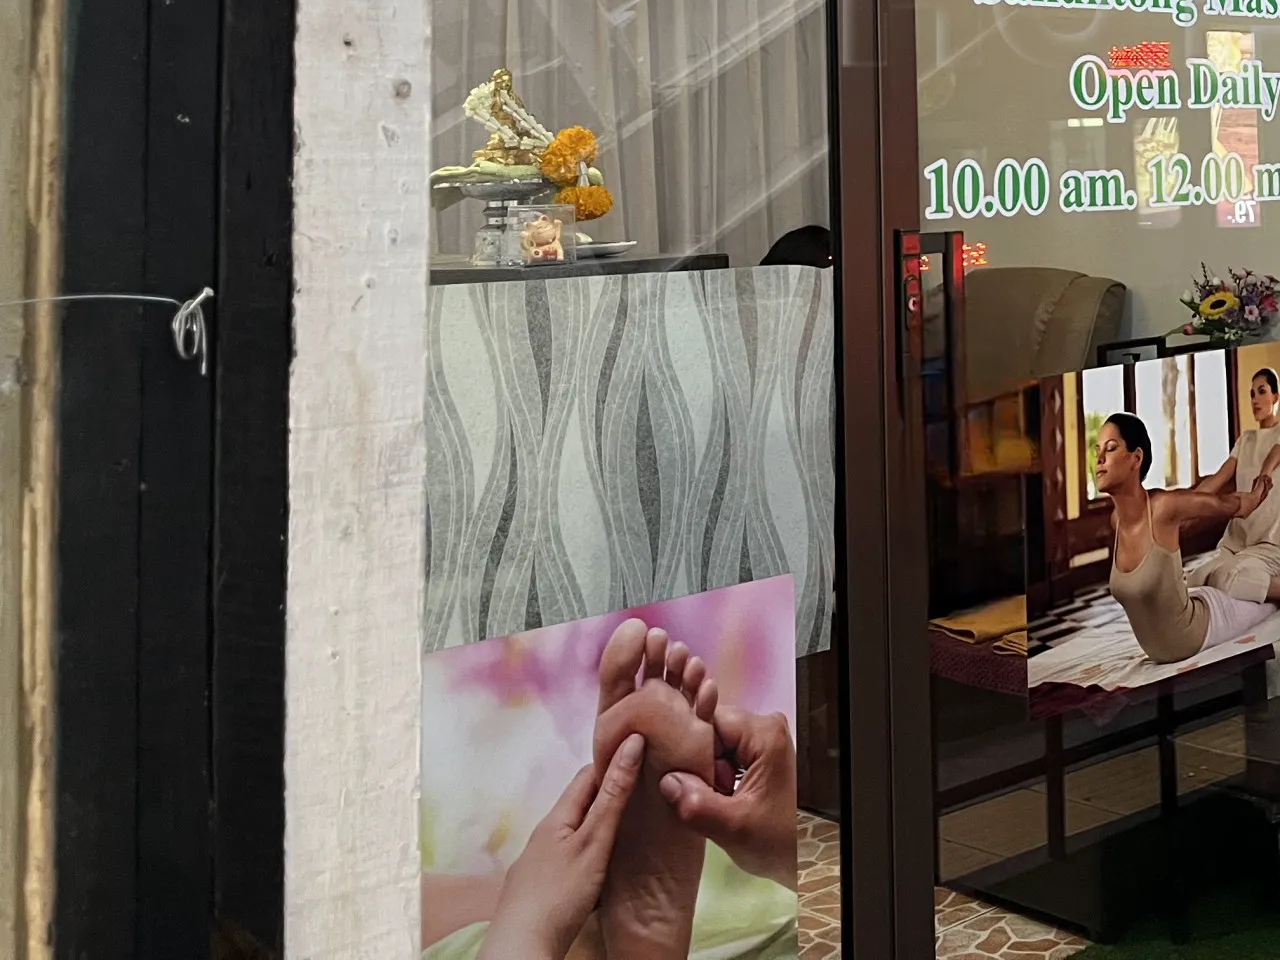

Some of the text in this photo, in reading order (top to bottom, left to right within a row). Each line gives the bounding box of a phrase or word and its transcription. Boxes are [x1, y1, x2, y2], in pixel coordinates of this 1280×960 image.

[1072, 56, 1179, 120] Open
[925, 159, 1048, 218] 10.00
[1060, 170, 1136, 212] am.
[1148, 155, 1244, 206] 12.00
